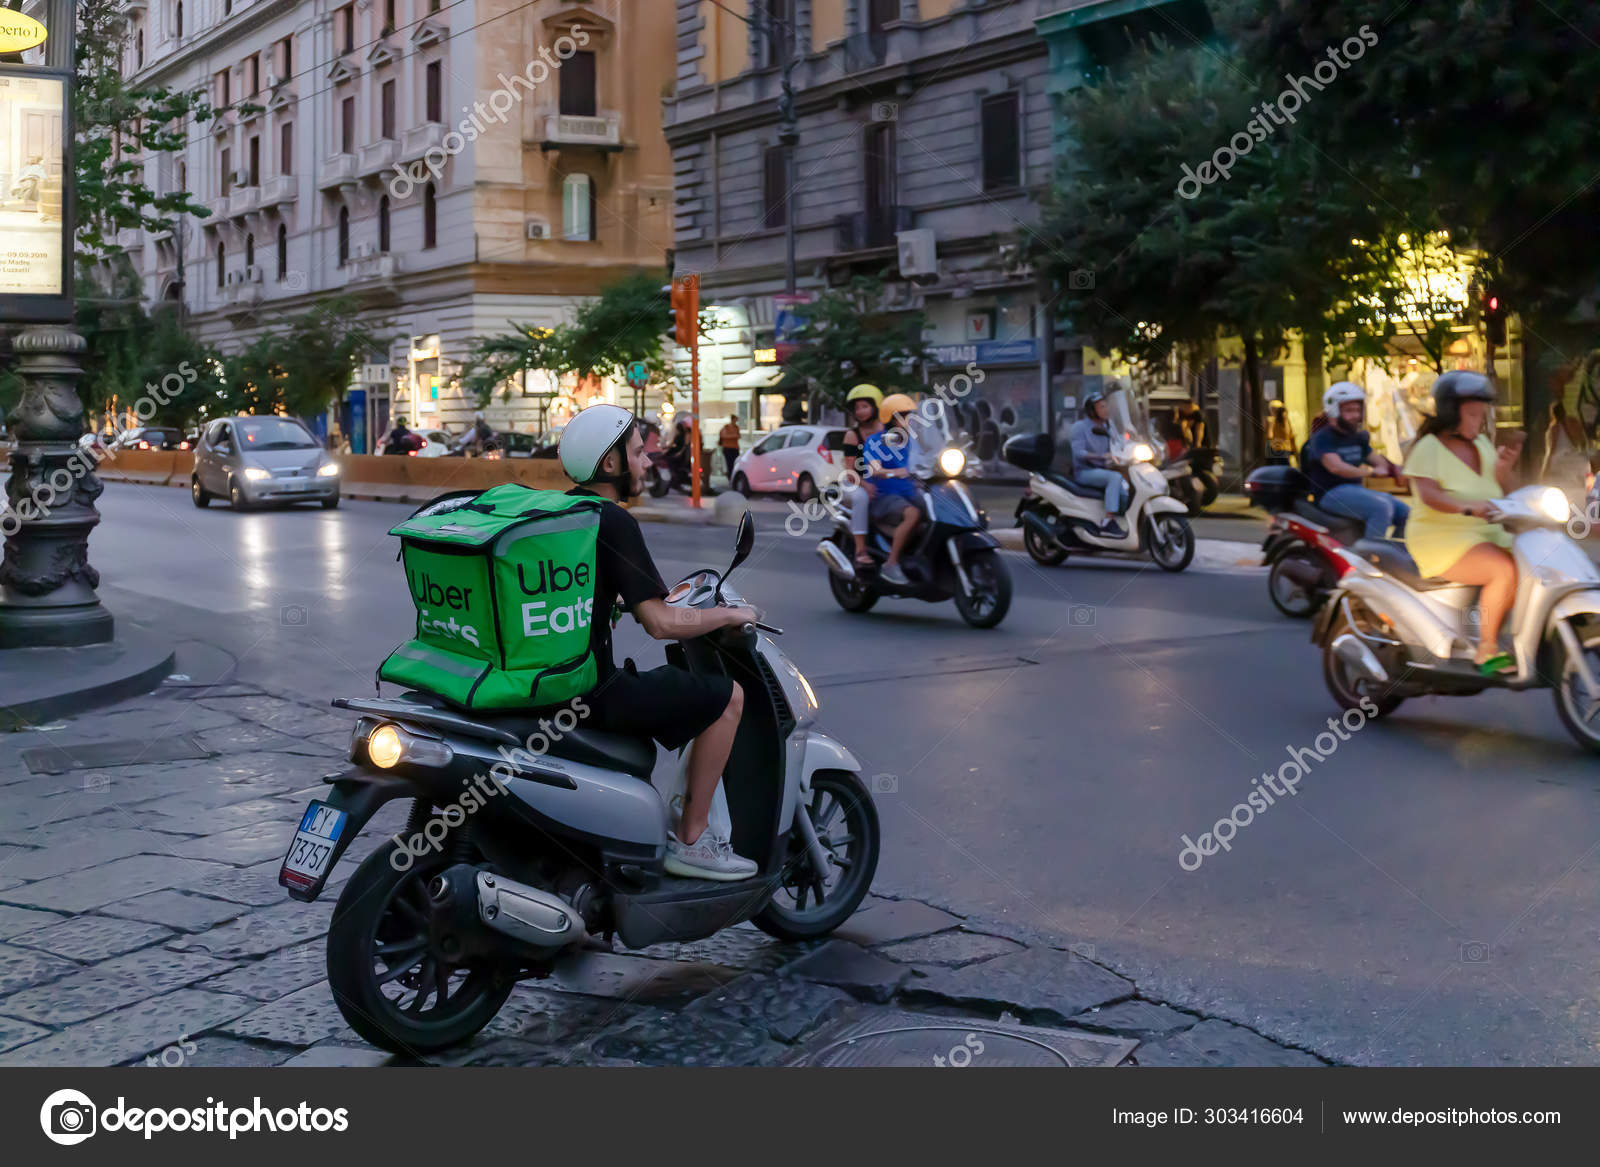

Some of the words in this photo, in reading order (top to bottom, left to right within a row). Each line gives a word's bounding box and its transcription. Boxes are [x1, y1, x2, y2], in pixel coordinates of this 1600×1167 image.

[411, 569, 473, 611] Uber
[517, 559, 590, 596] Ube
[521, 595, 594, 637] Eats
[310, 807, 332, 833] CY
[289, 837, 331, 871] 73757
